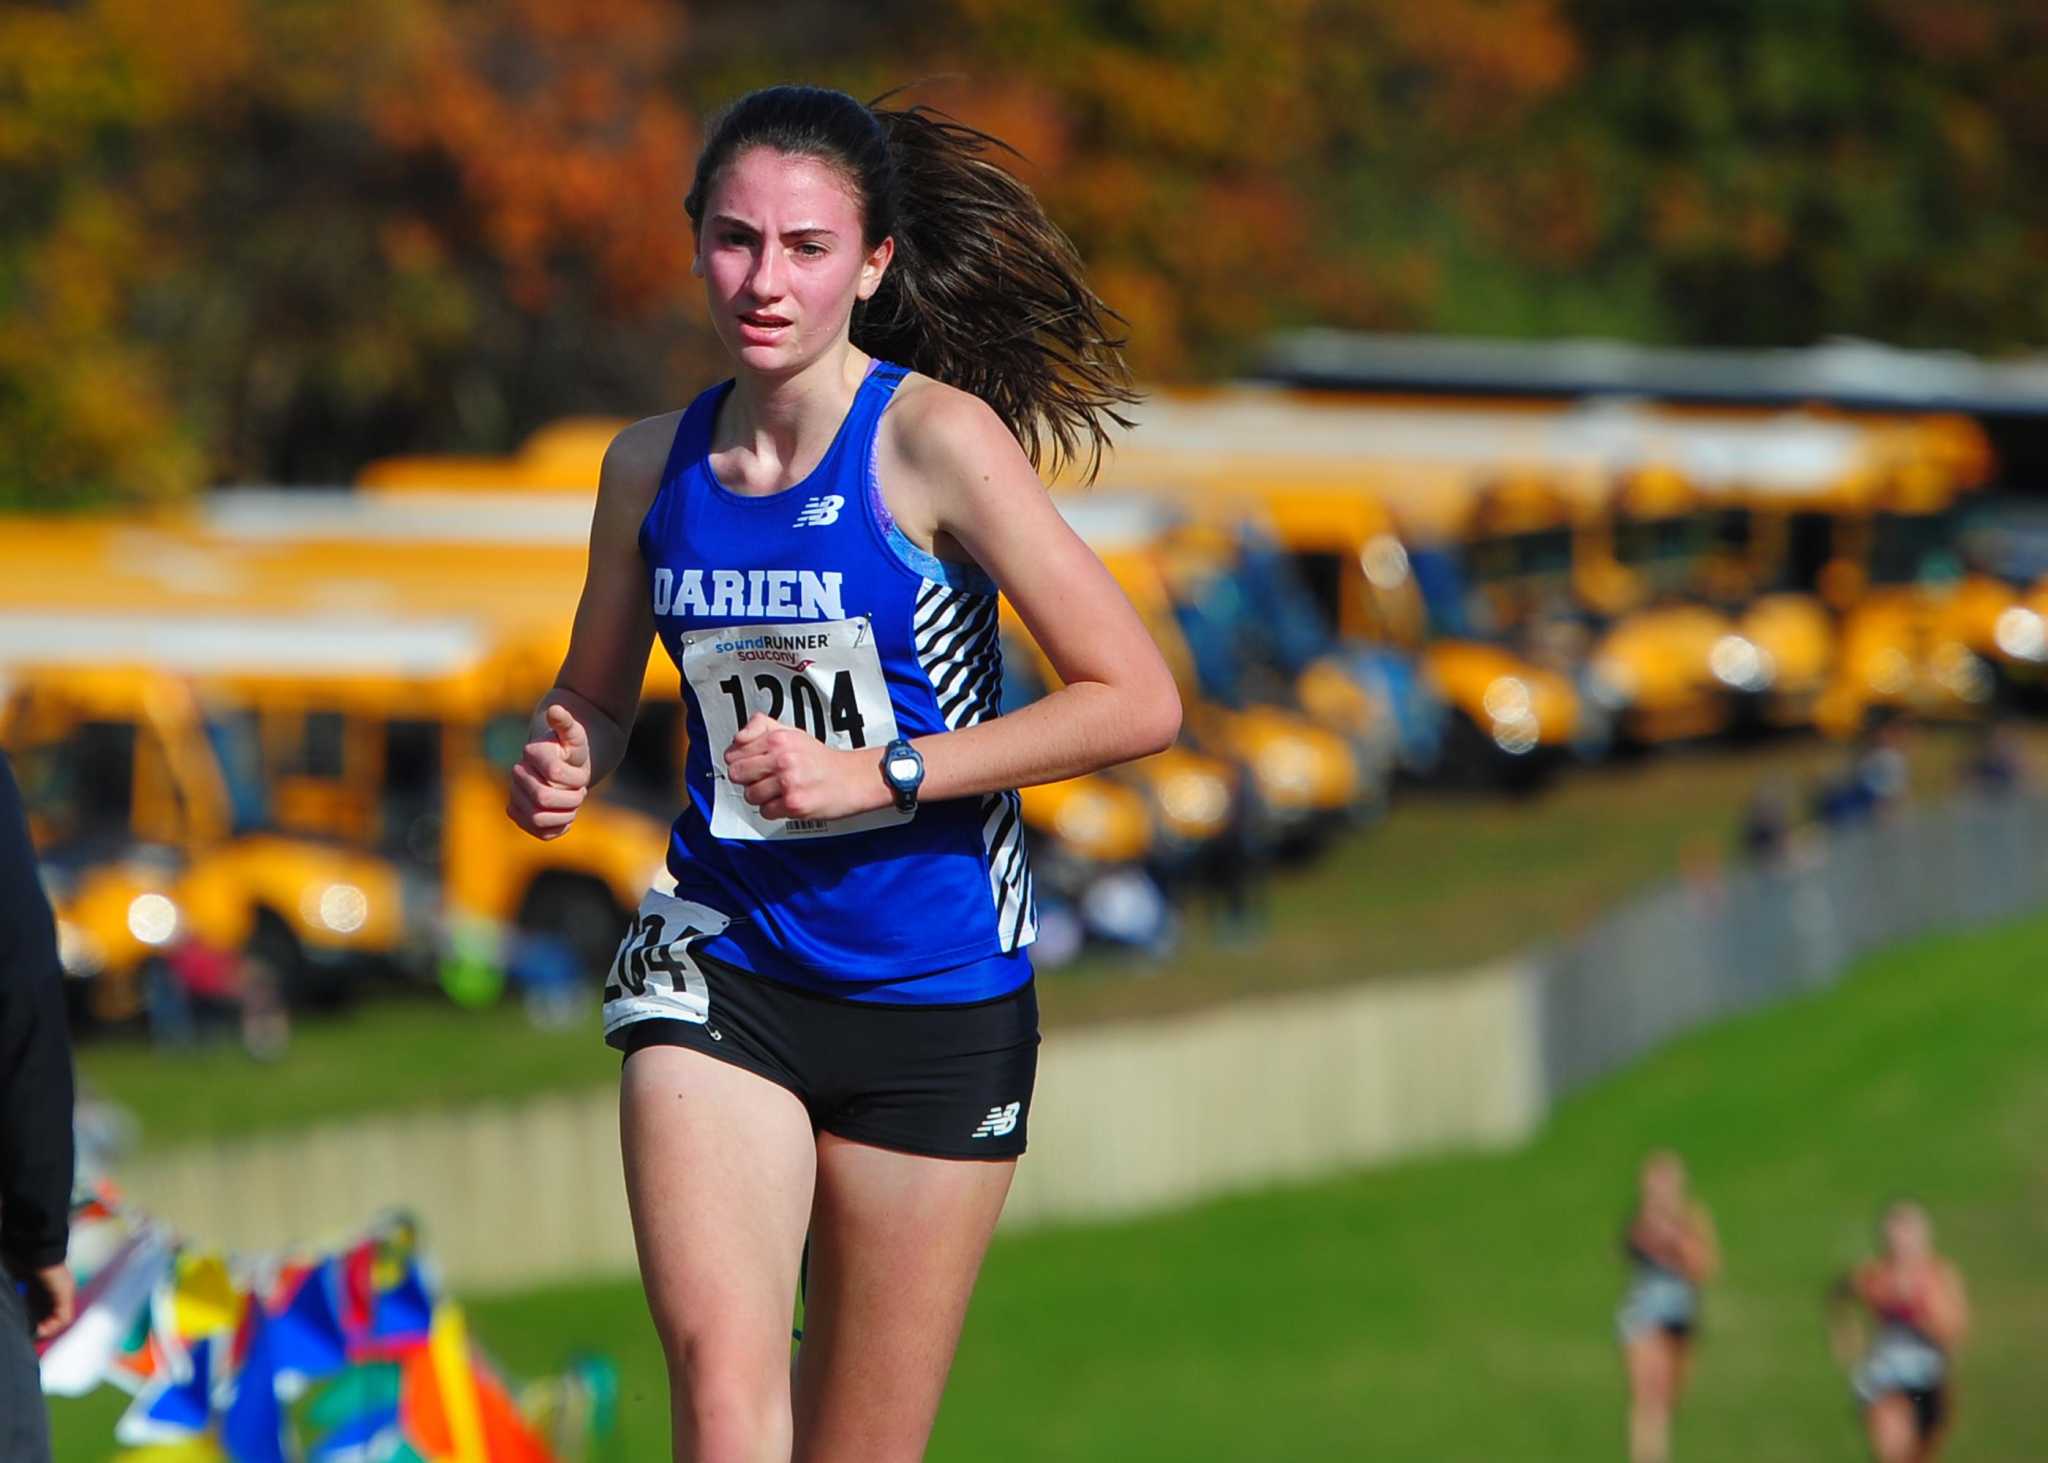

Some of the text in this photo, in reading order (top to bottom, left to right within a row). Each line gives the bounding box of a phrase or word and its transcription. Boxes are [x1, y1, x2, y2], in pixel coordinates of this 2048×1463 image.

[653, 567, 846, 621] DARIEN
[715, 633, 829, 654] soundRUNNER
[737, 649, 797, 664] saucony
